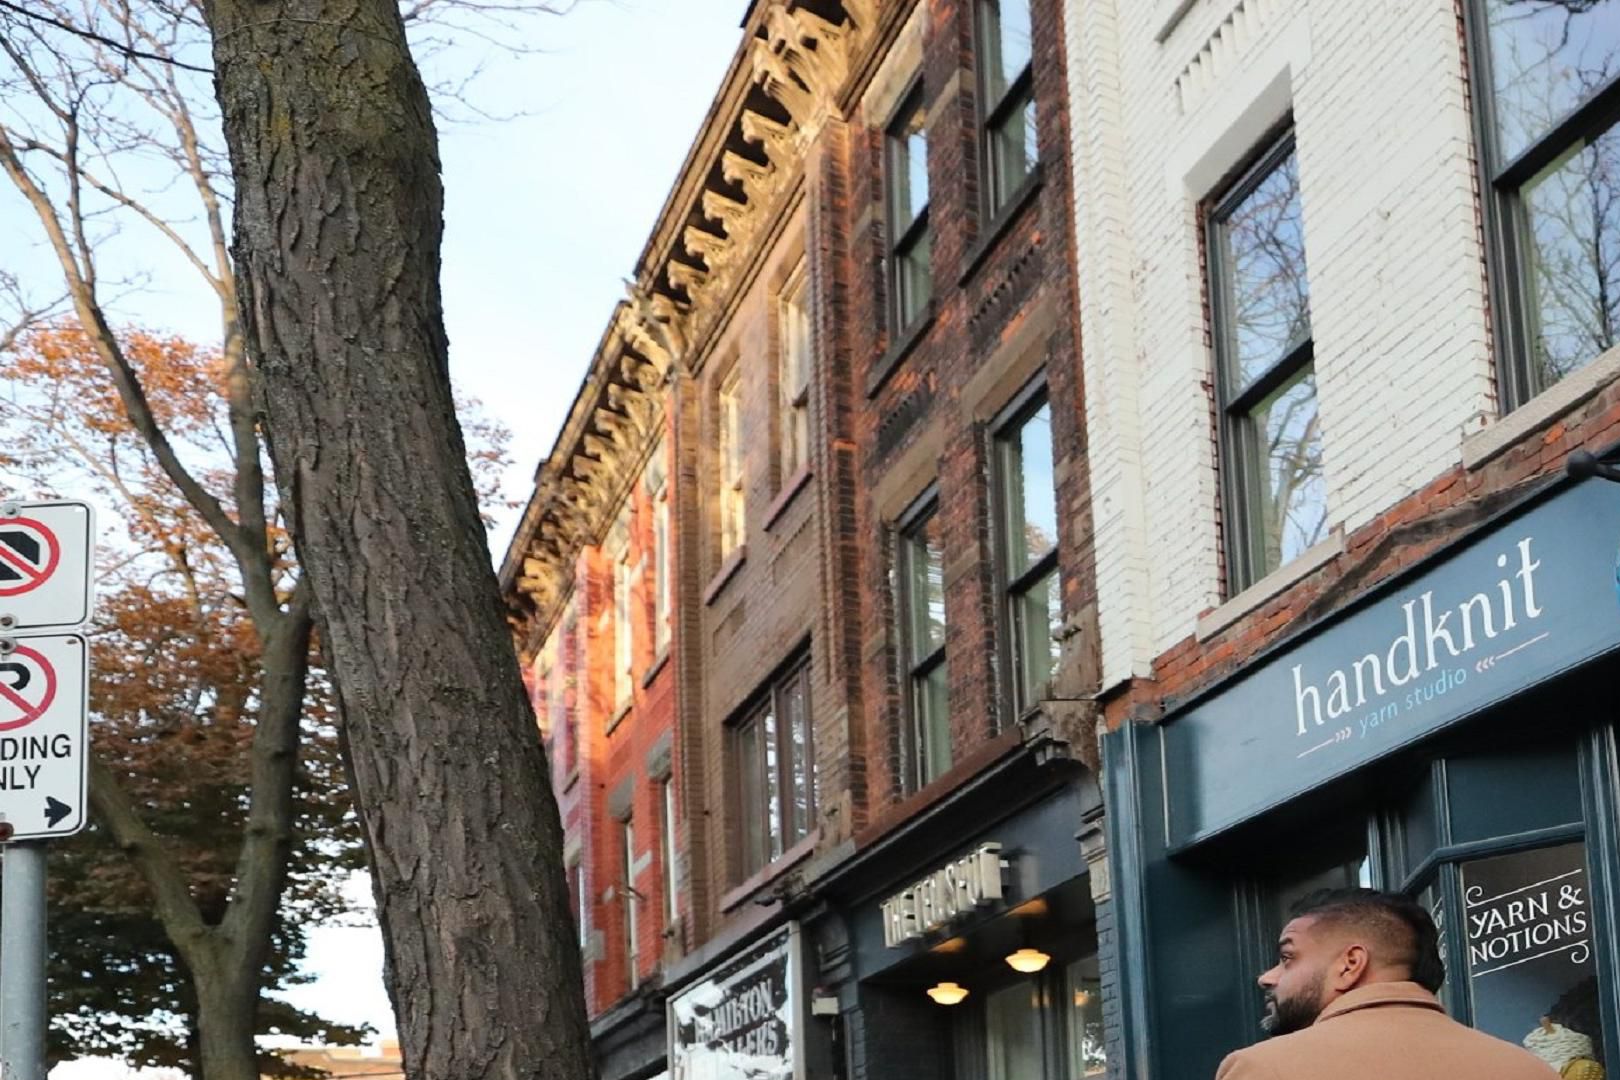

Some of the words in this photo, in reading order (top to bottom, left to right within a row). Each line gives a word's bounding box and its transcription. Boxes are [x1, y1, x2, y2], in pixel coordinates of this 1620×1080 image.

[1292, 537, 1543, 736] handknit
[1358, 701, 1399, 739] yarn
[1404, 668, 1467, 711] studio
[1469, 891, 1550, 939] YARN
[1557, 884, 1585, 910] &
[1470, 910, 1587, 966] NOTIONS
